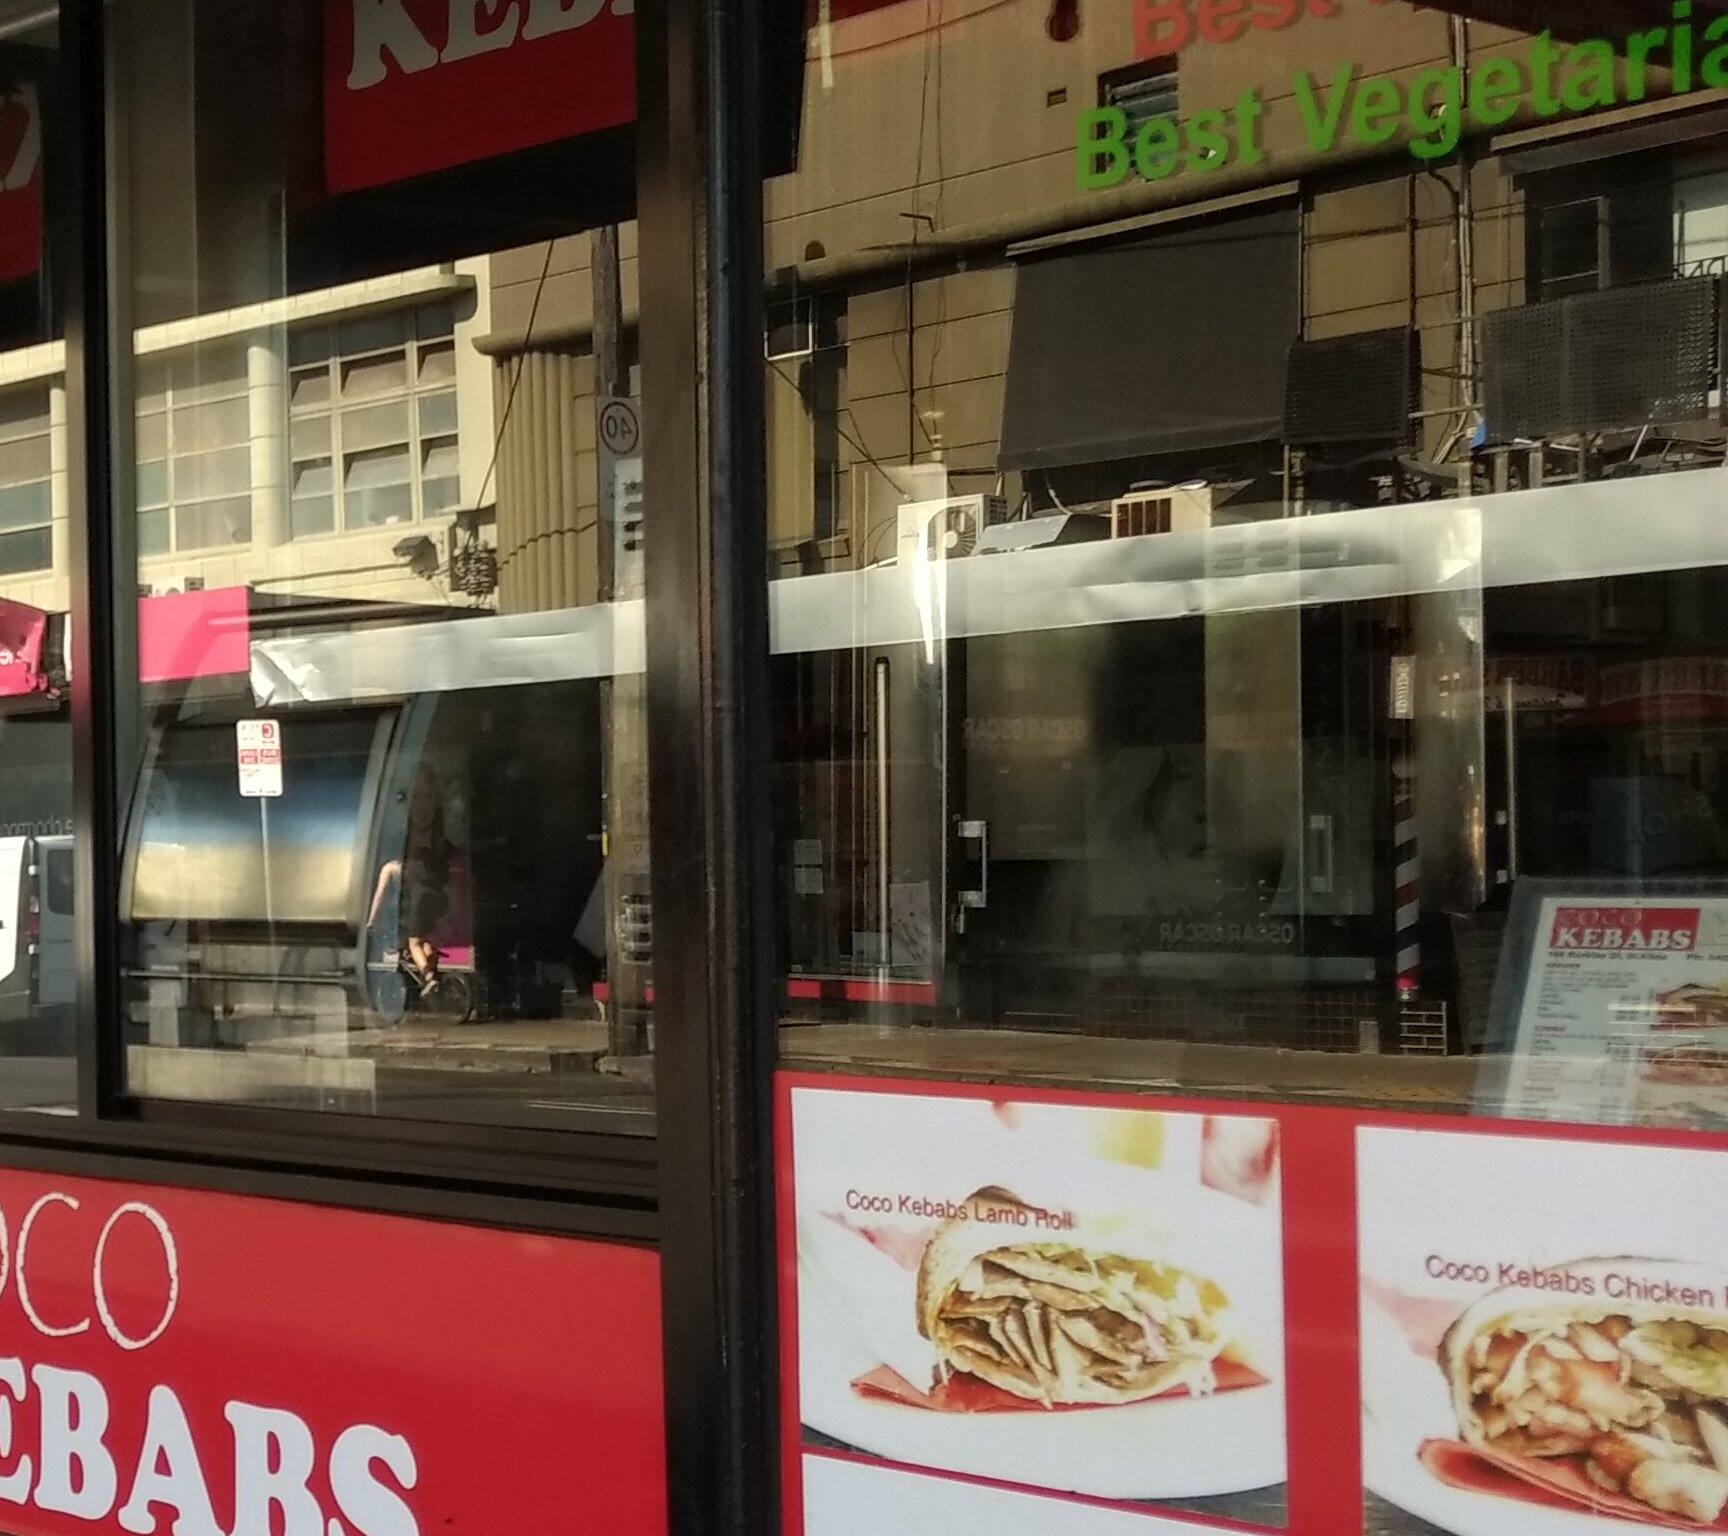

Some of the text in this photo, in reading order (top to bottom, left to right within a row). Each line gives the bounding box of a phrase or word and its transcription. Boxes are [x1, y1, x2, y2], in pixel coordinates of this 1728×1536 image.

[1074, 85, 1264, 192] Best
[1555, 927, 1692, 949] KEBABS
[845, 1189, 892, 1212] Coco
[897, 1194, 968, 1222] Kebabs
[973, 1201, 1028, 1227] Lamb
[1425, 1254, 1715, 1308] Coco Kebabs Chicken
